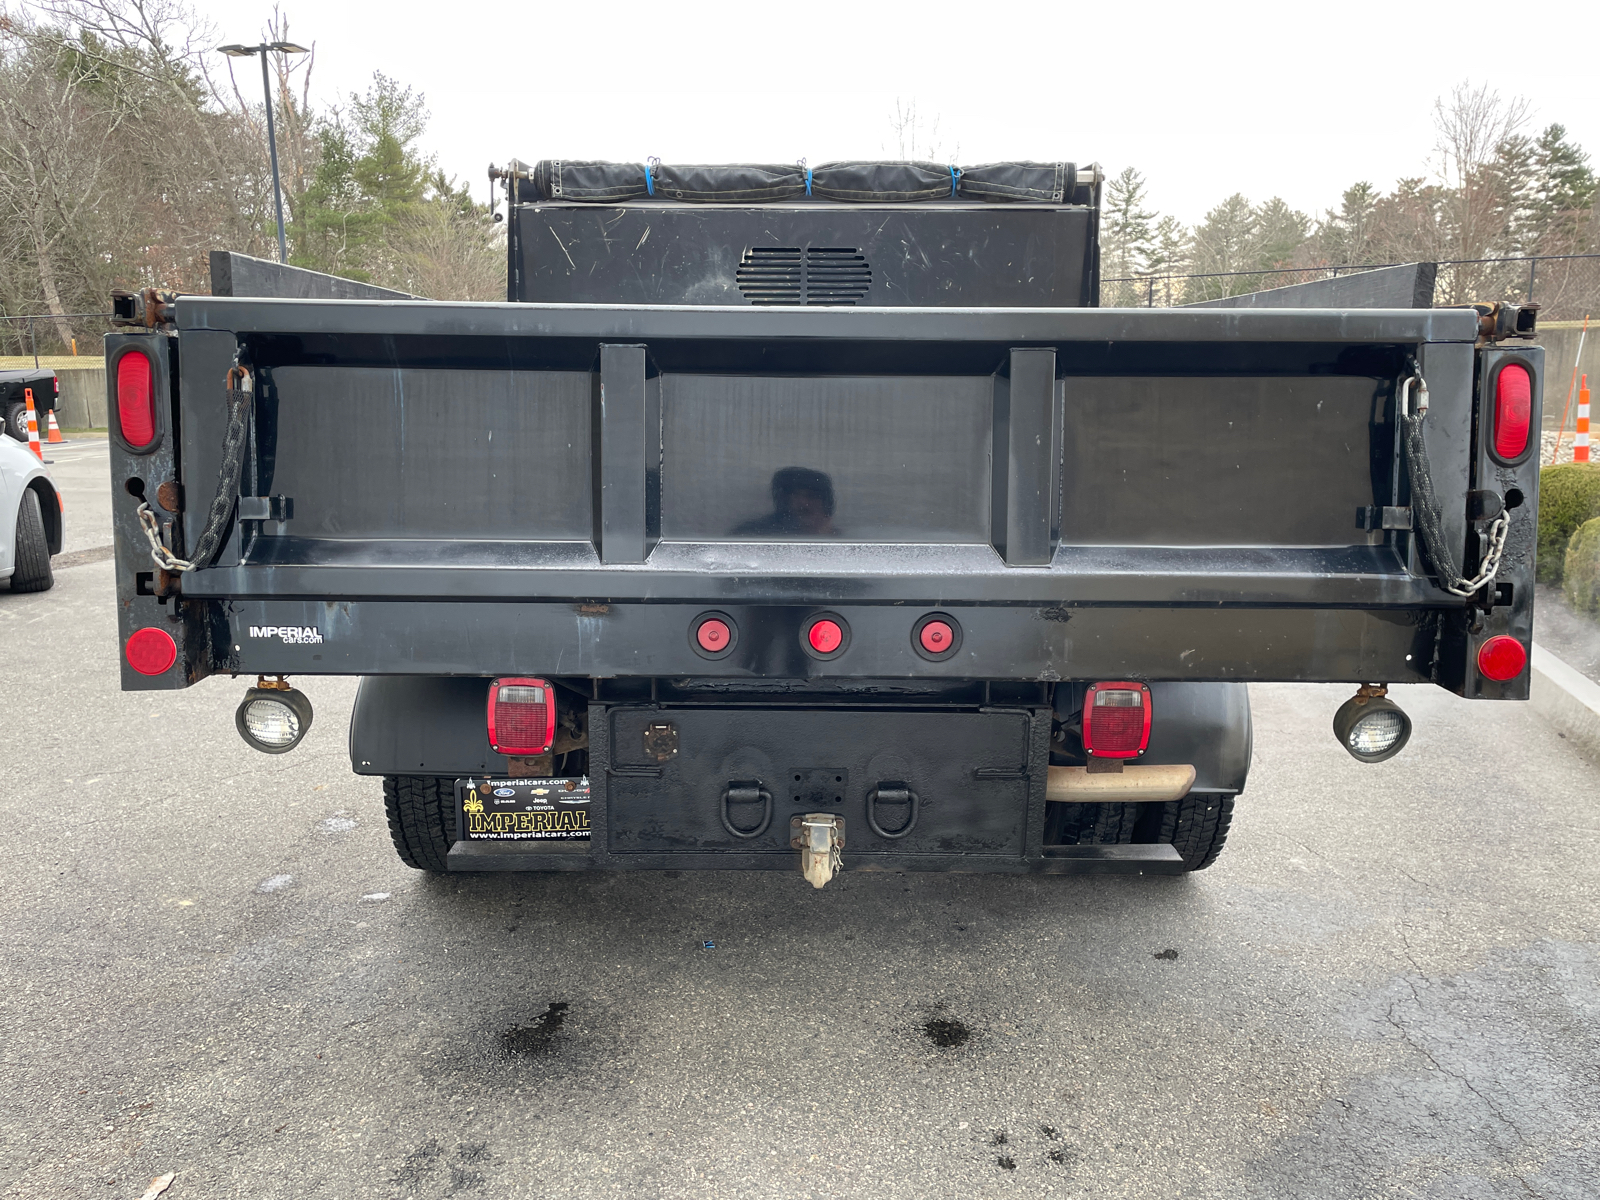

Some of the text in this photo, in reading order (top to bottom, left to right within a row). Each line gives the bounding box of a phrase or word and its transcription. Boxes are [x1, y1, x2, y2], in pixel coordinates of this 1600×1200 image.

[249, 627, 323, 638] IMPERIAL
[283, 636, 323, 644] cars.com
[469, 811, 590, 832] IMPERIAL
